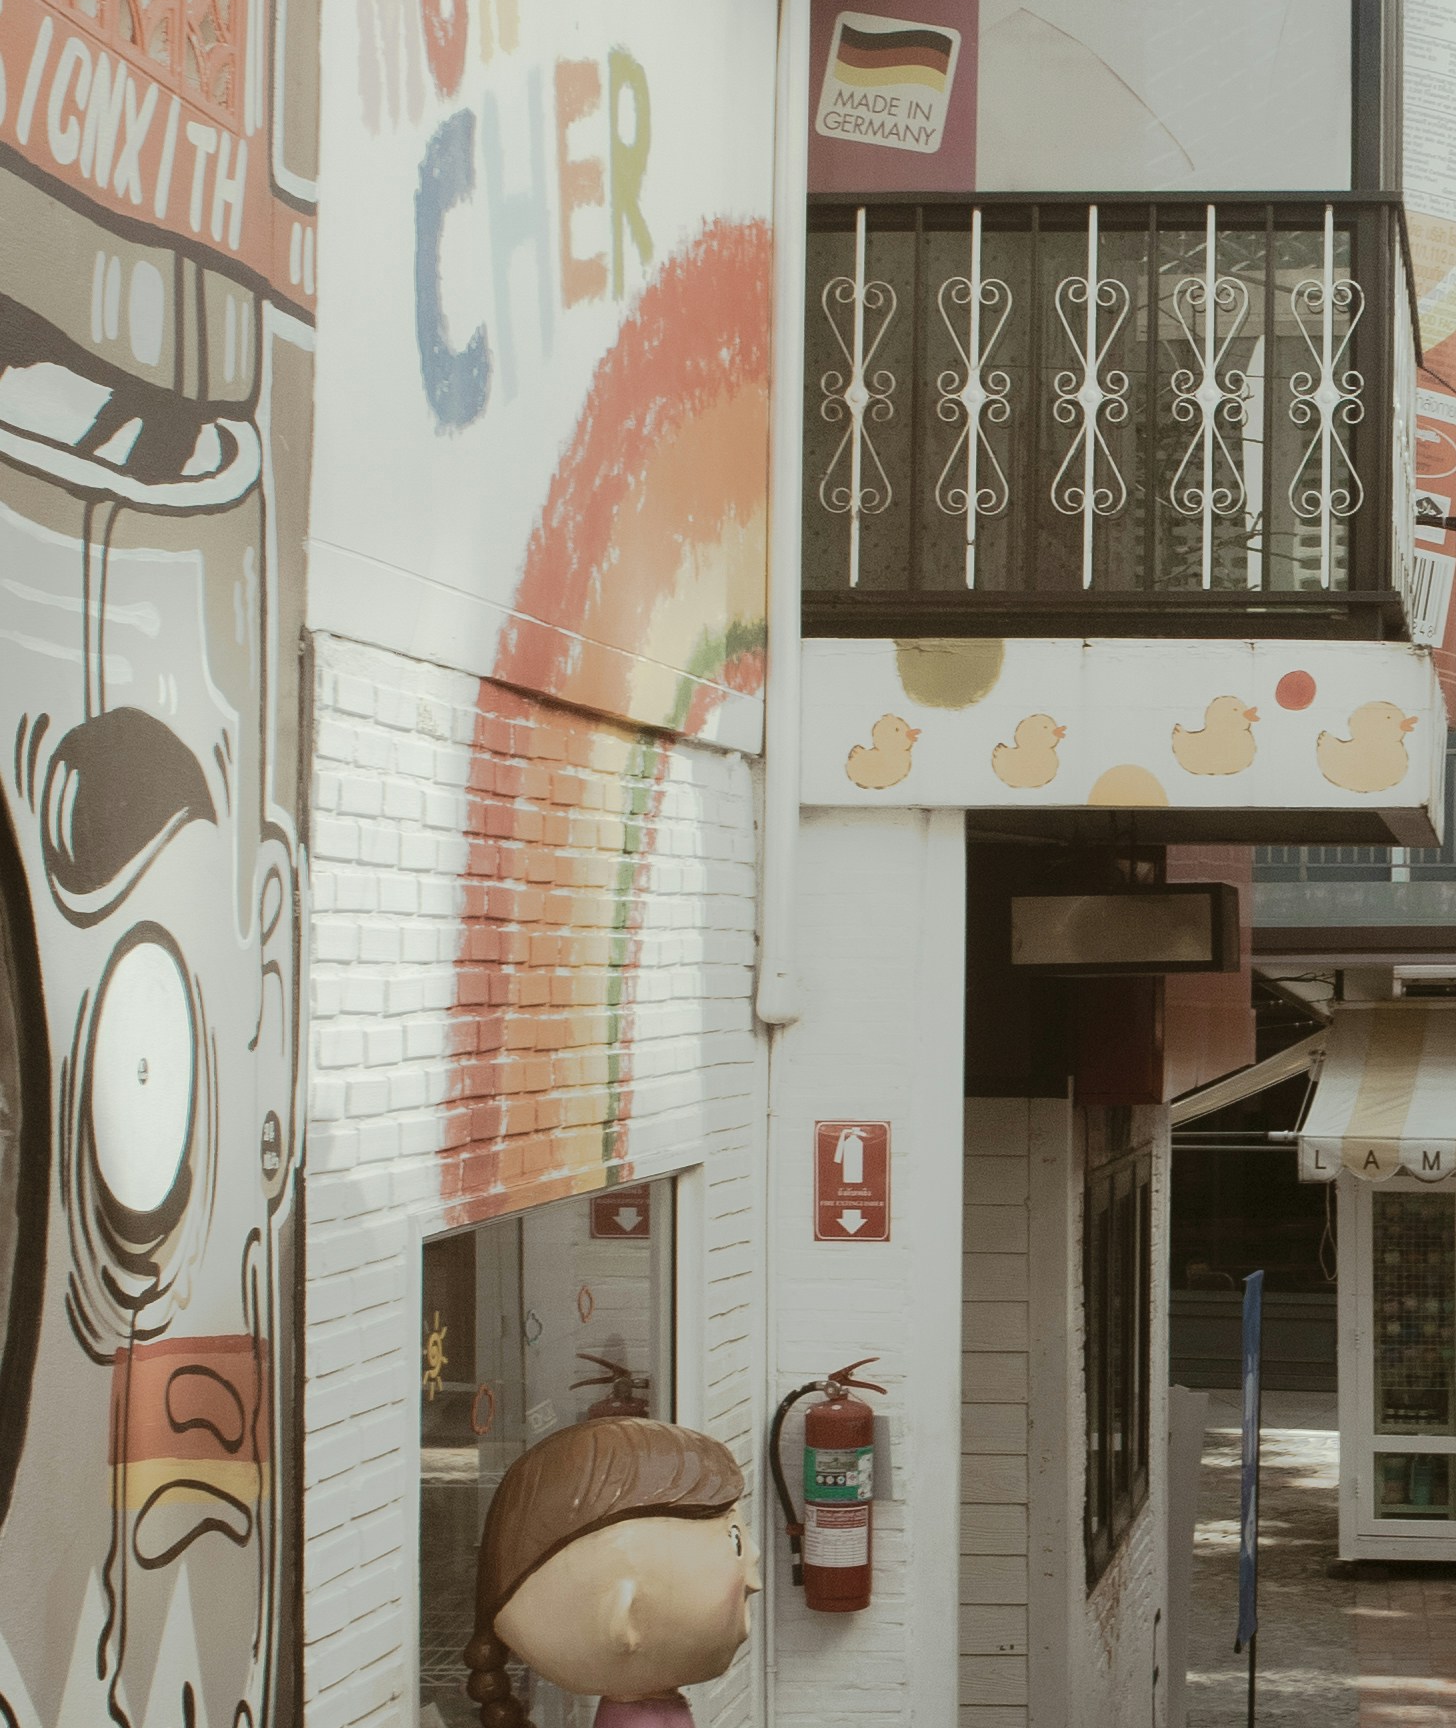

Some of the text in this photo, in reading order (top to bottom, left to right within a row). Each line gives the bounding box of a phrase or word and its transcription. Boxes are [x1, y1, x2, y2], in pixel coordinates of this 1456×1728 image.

[833, 88, 932, 122] MADE IN
[823, 111, 936, 145] GERMANY
[413, 42, 655, 437] CHER
